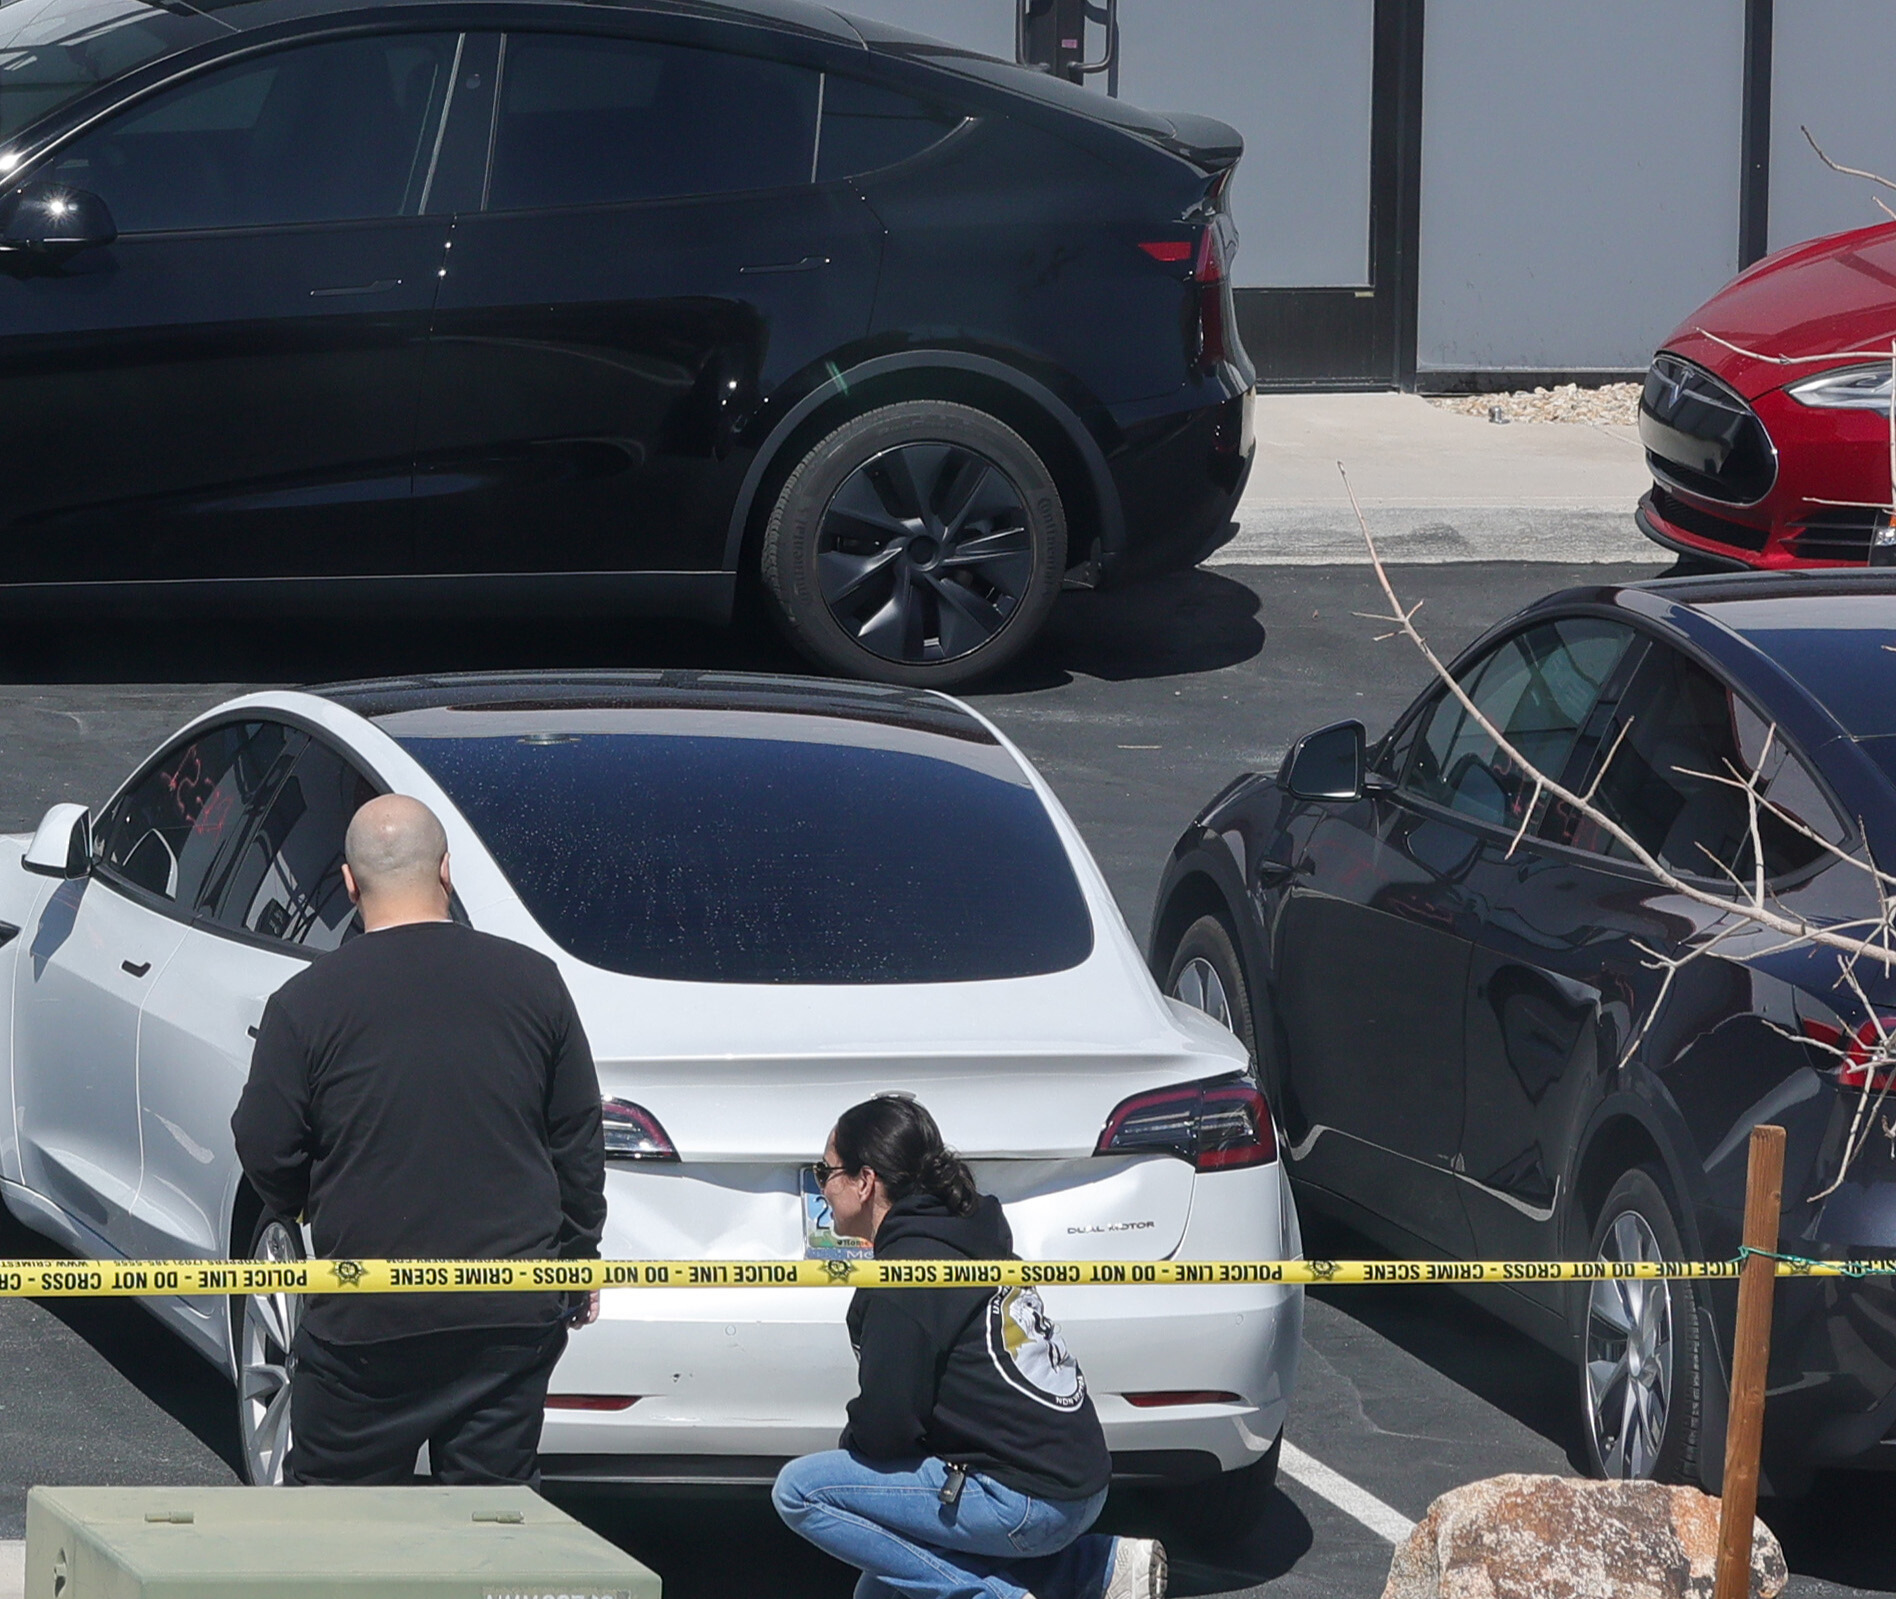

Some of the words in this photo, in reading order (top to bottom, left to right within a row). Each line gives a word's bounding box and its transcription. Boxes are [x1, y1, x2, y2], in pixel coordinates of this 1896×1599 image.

[41, 1272, 101, 1289] CROSS
[112, 1272, 147, 1288] NOT
[154, 1271, 178, 1288] DO
[198, 1270, 237, 1287] LINE
[243, 1270, 307, 1287] POLICE
[390, 1268, 448, 1285] SCENE
[454, 1268, 513, 1284] CRIME
[533, 1267, 593, 1283] CROSS
[603, 1267, 638, 1283] NOT
[645, 1267, 669, 1283] DO
[688, 1266, 727, 1283] LINE
[733, 1266, 797, 1282] POLICE
[879, 1266, 937, 1282] SCENE
[943, 1266, 1002, 1282] CRIME
[1021, 1265, 1080, 1281] CROSS
[1090, 1265, 1125, 1281] NOT
[1132, 1265, 1155, 1281] DO
[1175, 1265, 1213, 1280] LINE
[1219, 1265, 1282, 1280] POLICE
